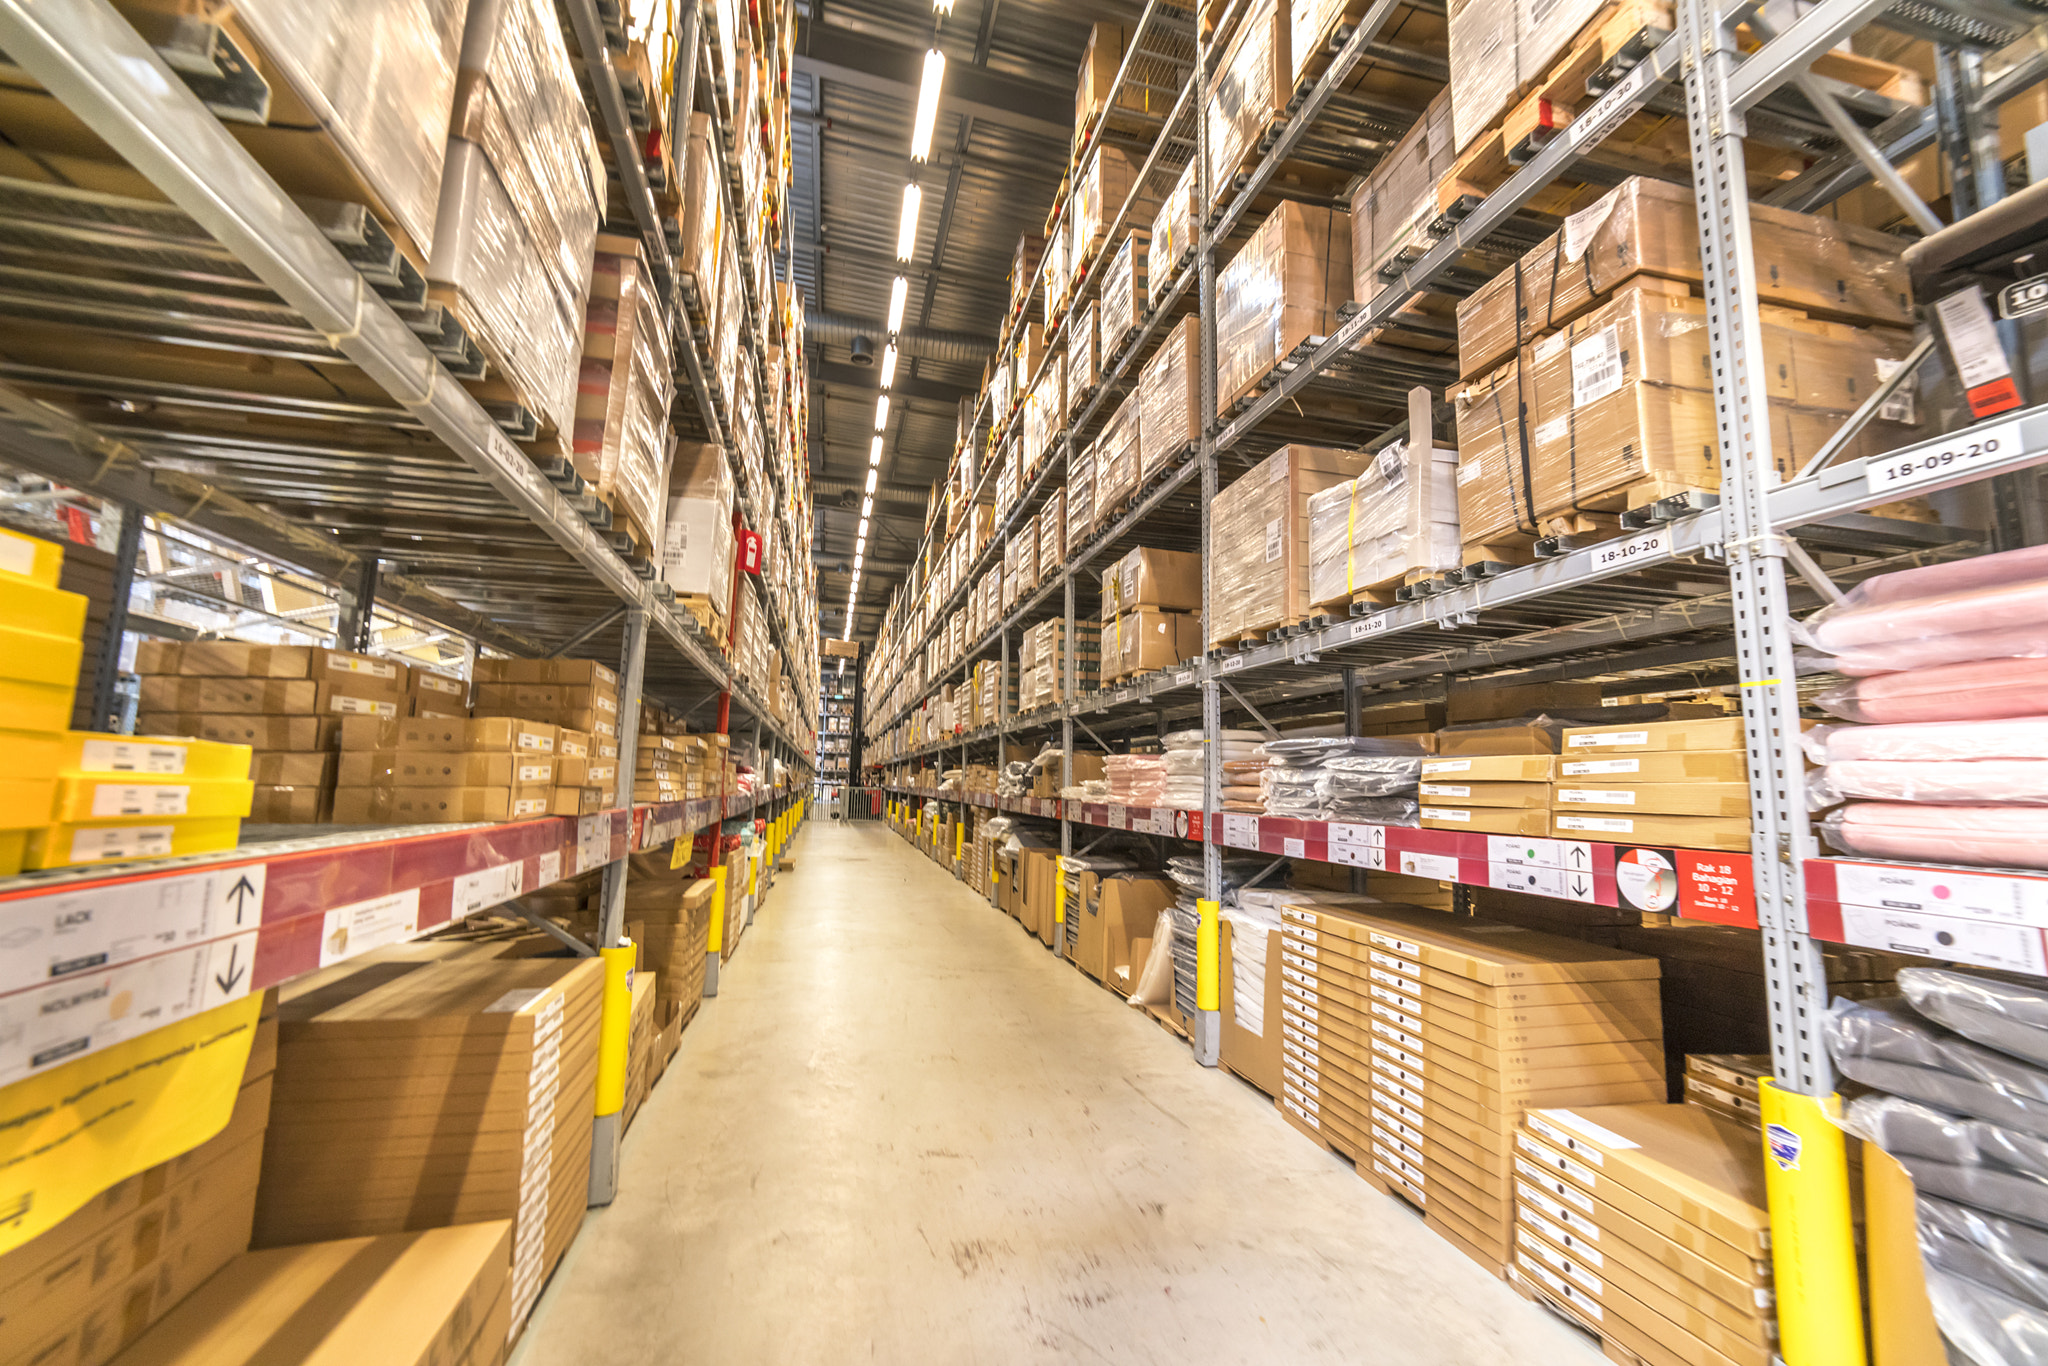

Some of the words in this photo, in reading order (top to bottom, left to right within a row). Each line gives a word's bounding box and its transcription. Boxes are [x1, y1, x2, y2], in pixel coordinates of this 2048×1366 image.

[1579, 81, 1632, 133] 18-10-30
[2010, 283, 2048, 306] 10
[1342, 312, 1367, 337] 18-11-30
[1887, 439, 2000, 480] 18-09-20
[1601, 539, 1659, 563] 18-10-20
[1355, 620, 1382, 633] 18-11-20
[1692, 872, 1738, 886] Bahagian
[1696, 862, 1716, 873] Rak
[1719, 865, 1732, 875] 18
[1698, 883, 1710, 892] 10
[1721, 886, 1734, 896] 12
[54, 909, 92, 929] LACK
